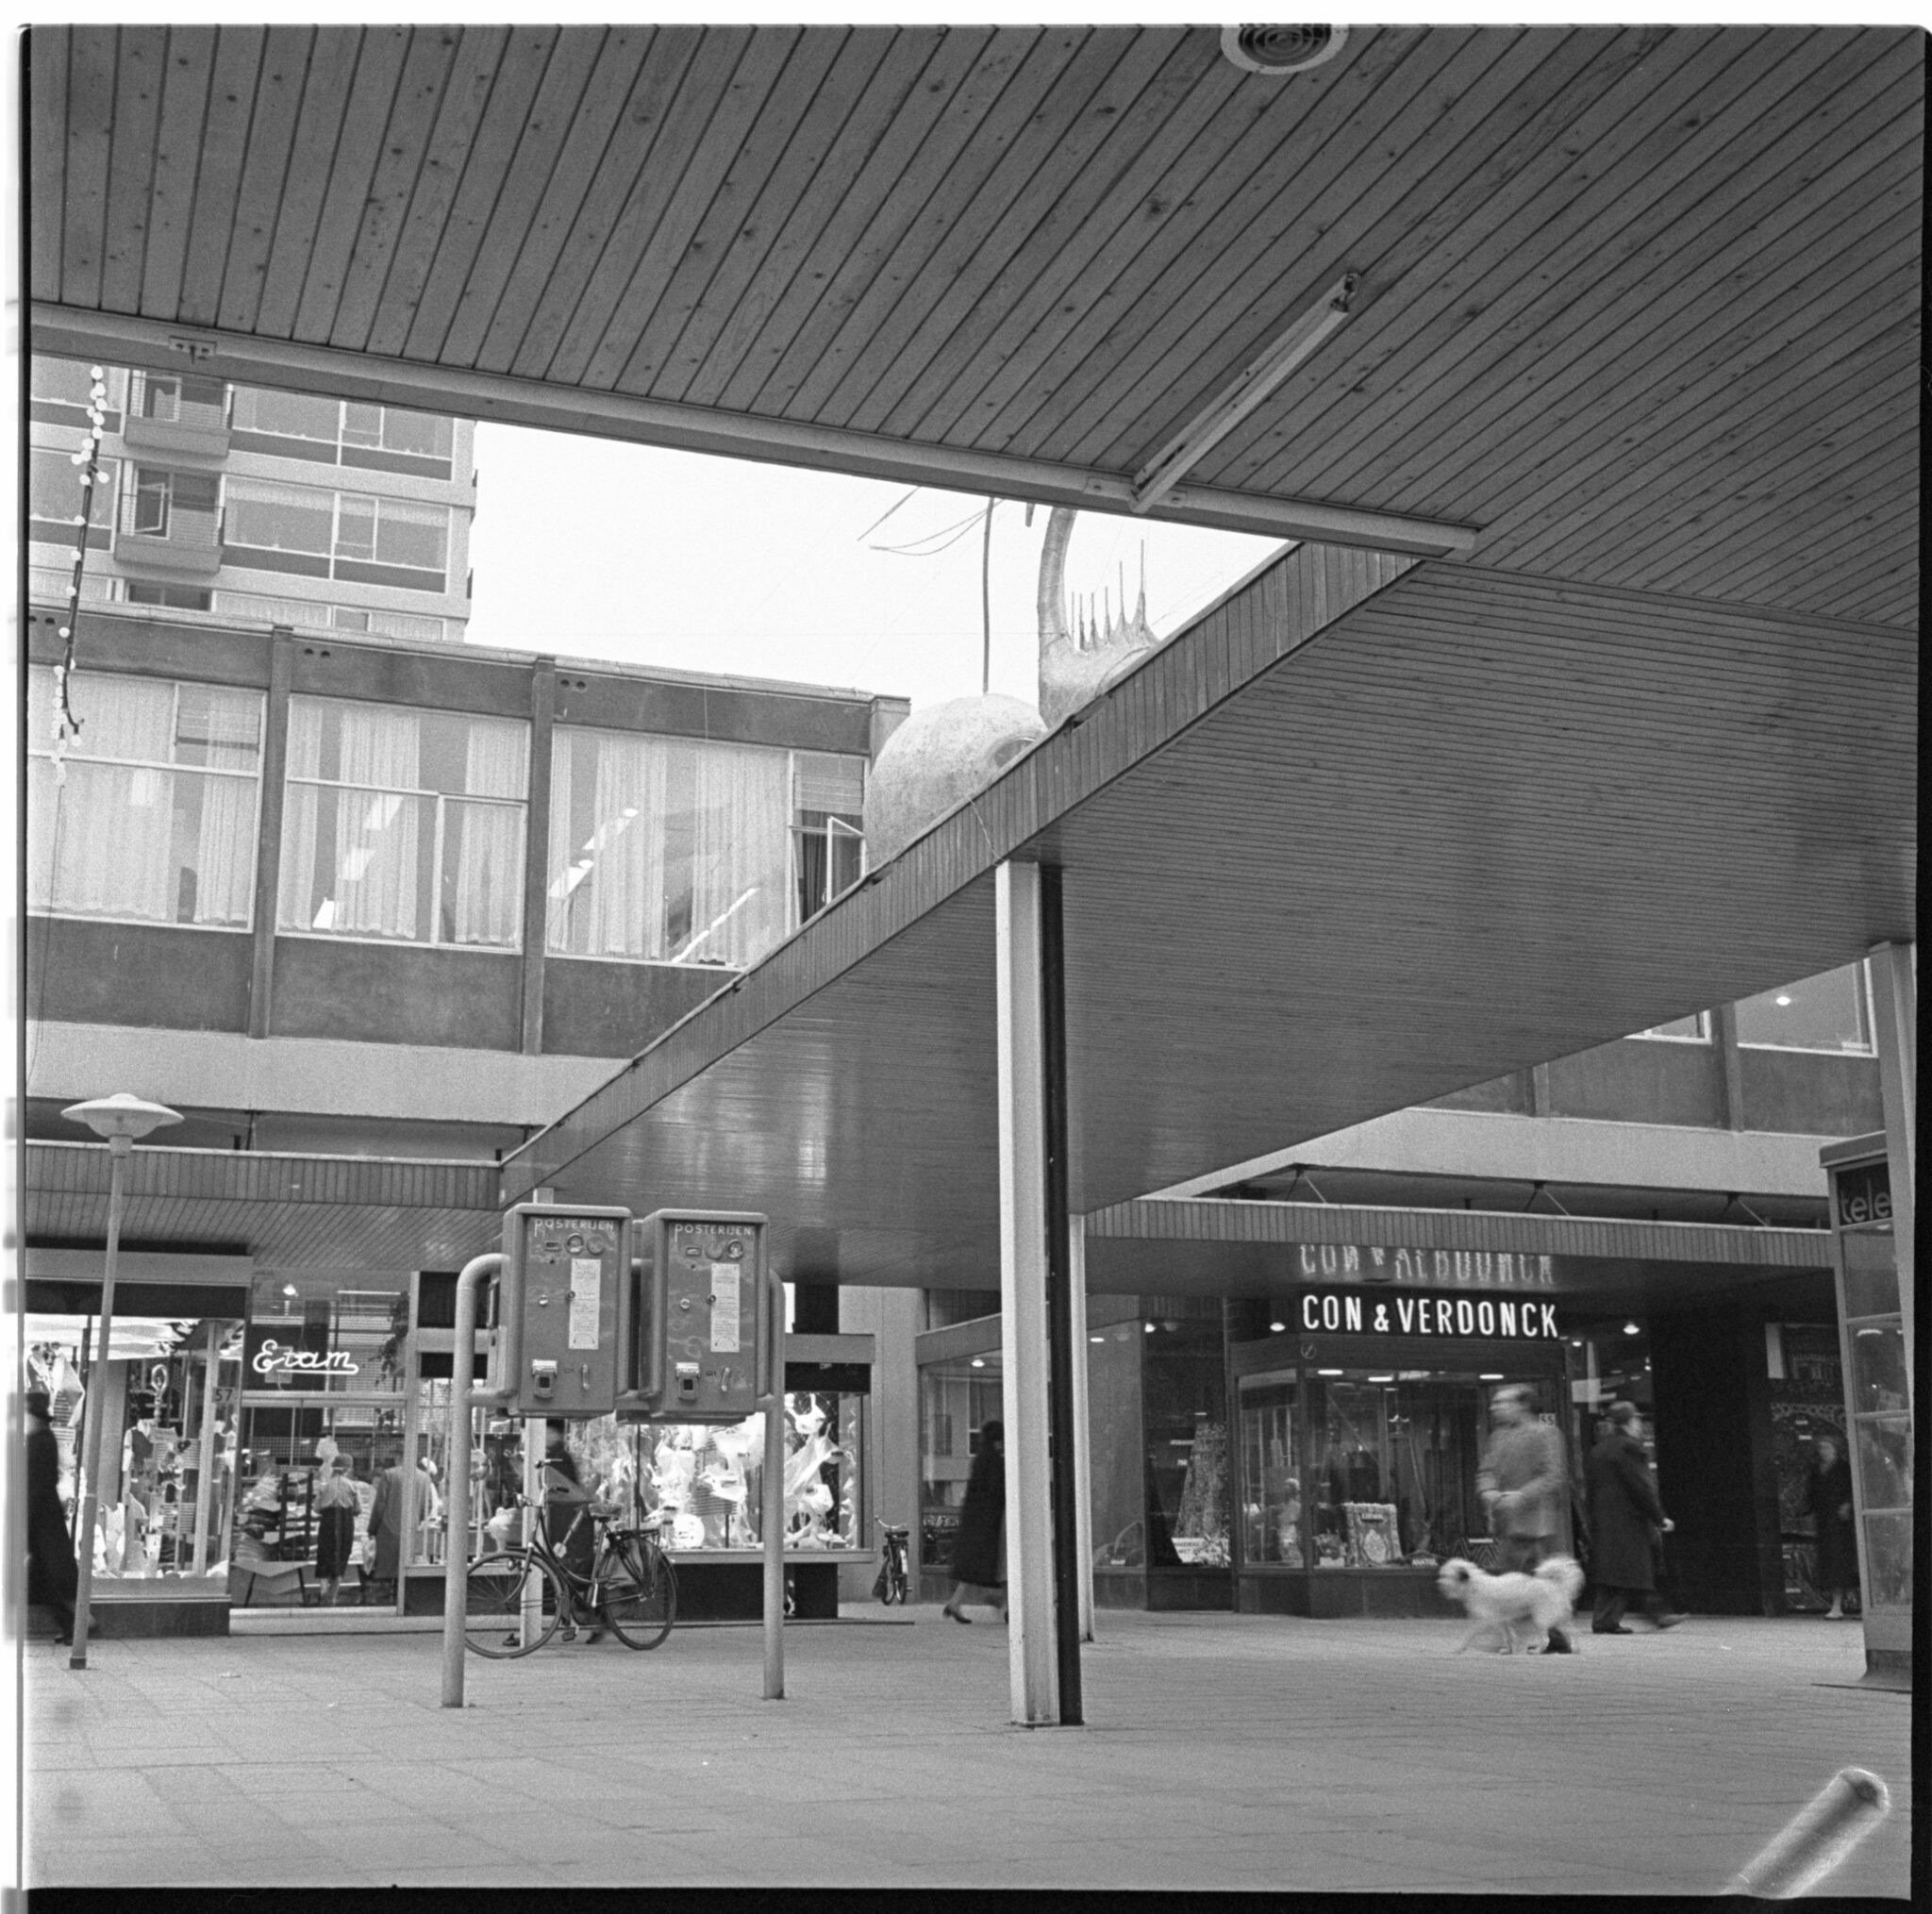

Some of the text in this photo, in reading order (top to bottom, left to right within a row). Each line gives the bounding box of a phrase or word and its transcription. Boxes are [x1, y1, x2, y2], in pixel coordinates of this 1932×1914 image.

[1303, 1294, 1558, 1338] CON & VERDONCK
[253, 1339, 359, 1374] Etam
[215, 1389, 233, 1402] 57
